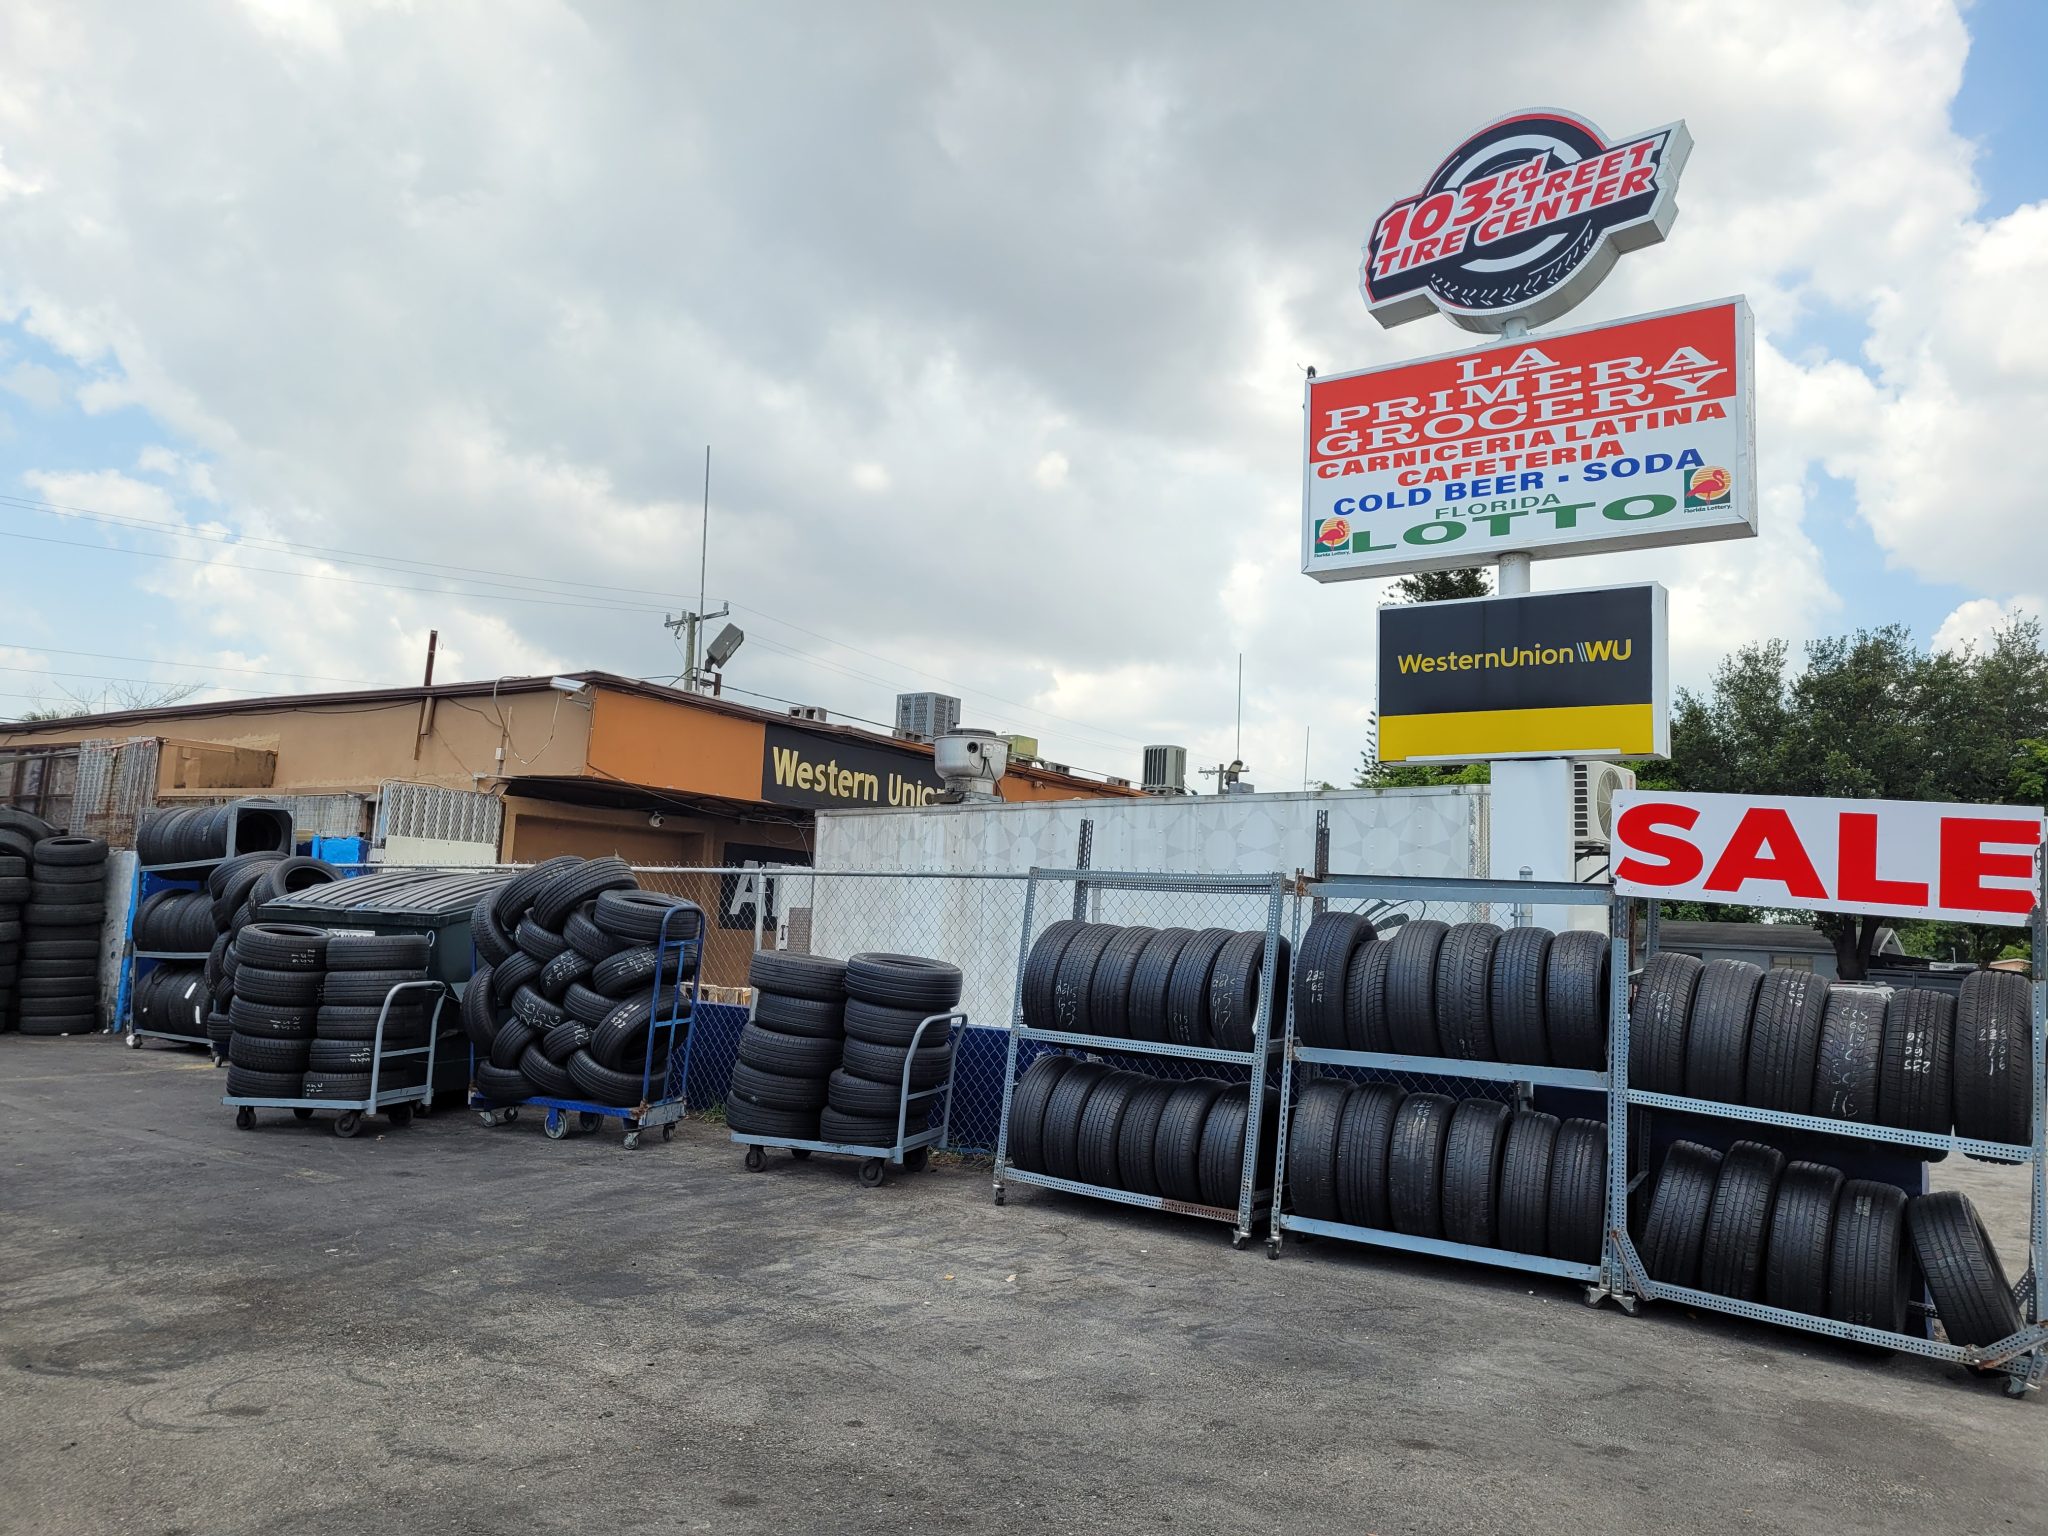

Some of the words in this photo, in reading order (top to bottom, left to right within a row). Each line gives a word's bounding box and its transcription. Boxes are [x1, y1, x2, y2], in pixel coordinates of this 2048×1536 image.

[1493, 140, 1655, 214] STREET
[1378, 229, 1465, 275] TIRE
[1477, 166, 1654, 242] CENTER
[1325, 345, 1718, 432] PRIMERA
[1457, 347, 1560, 384] LA
[1317, 367, 1728, 456] GROCERY
[1317, 430, 1557, 479] CARNICERIA
[1565, 402, 1727, 440] LATINA
[1334, 488, 1432, 516] COLD
[1445, 471, 1545, 501] BEER
[1583, 448, 1705, 482] SODA
[1397, 440, 1624, 487] CAFETERIA
[1352, 494, 1677, 553] LOTTO
[1435, 493, 1561, 519] FLORIDA
[773, 746, 878, 801] Western
[888, 773, 946, 807] Unio
[1615, 802, 2041, 914] SALE
